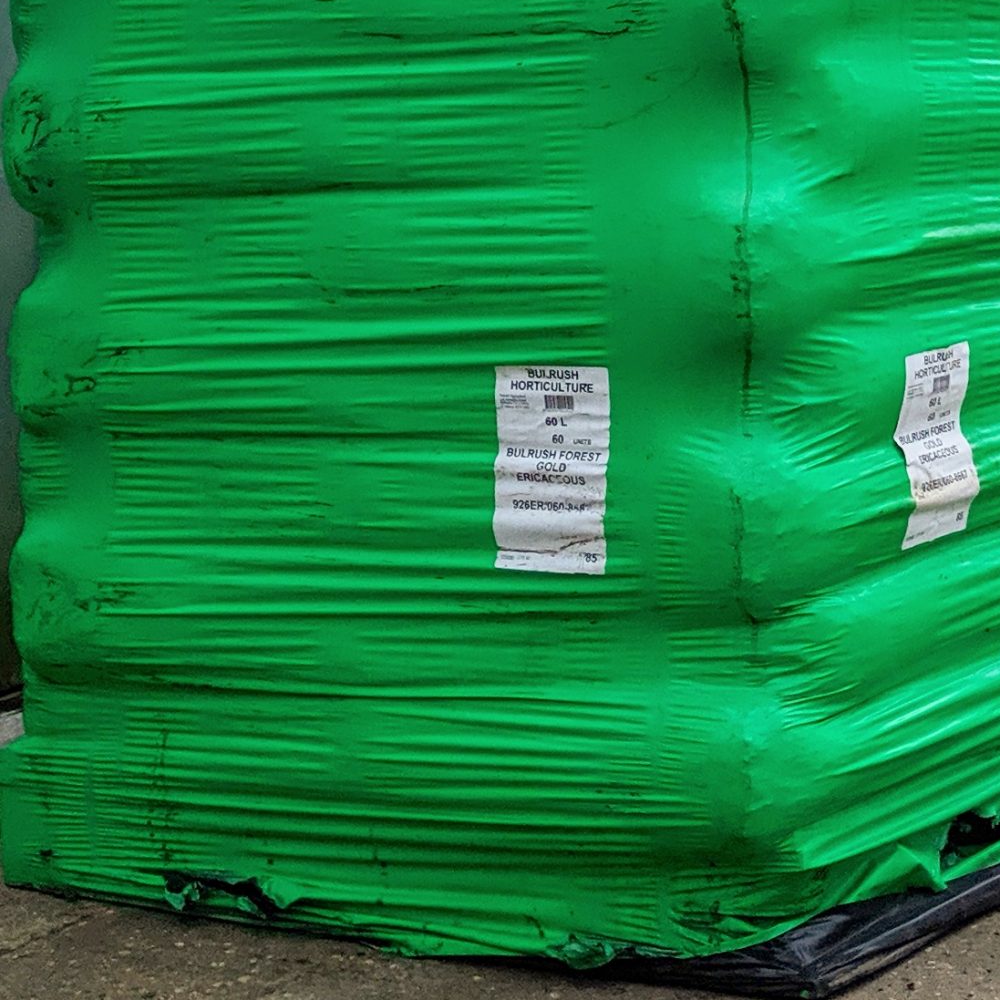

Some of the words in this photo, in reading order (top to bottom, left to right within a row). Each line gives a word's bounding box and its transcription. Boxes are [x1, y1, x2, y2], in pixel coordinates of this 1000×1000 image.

[527, 368, 579, 380] BULRUSH
[914, 359, 961, 379] HORTICULTURE
[510, 381, 594, 393] HORTICULTURE
[545, 417, 558, 426] 60
[561, 417, 567, 426] L
[552, 434, 564, 444] 60
[898, 429, 930, 446] BULRUSH
[930, 421, 955, 437] FOREST
[923, 438, 943, 450] GOLD
[506, 447, 556, 460] BULRUSH
[559, 450, 602, 462] FOREST
[918, 445, 960, 465] ERICACEOUS
[536, 462, 567, 472] GOLD
[516, 473, 586, 485] ERICACEOUS
